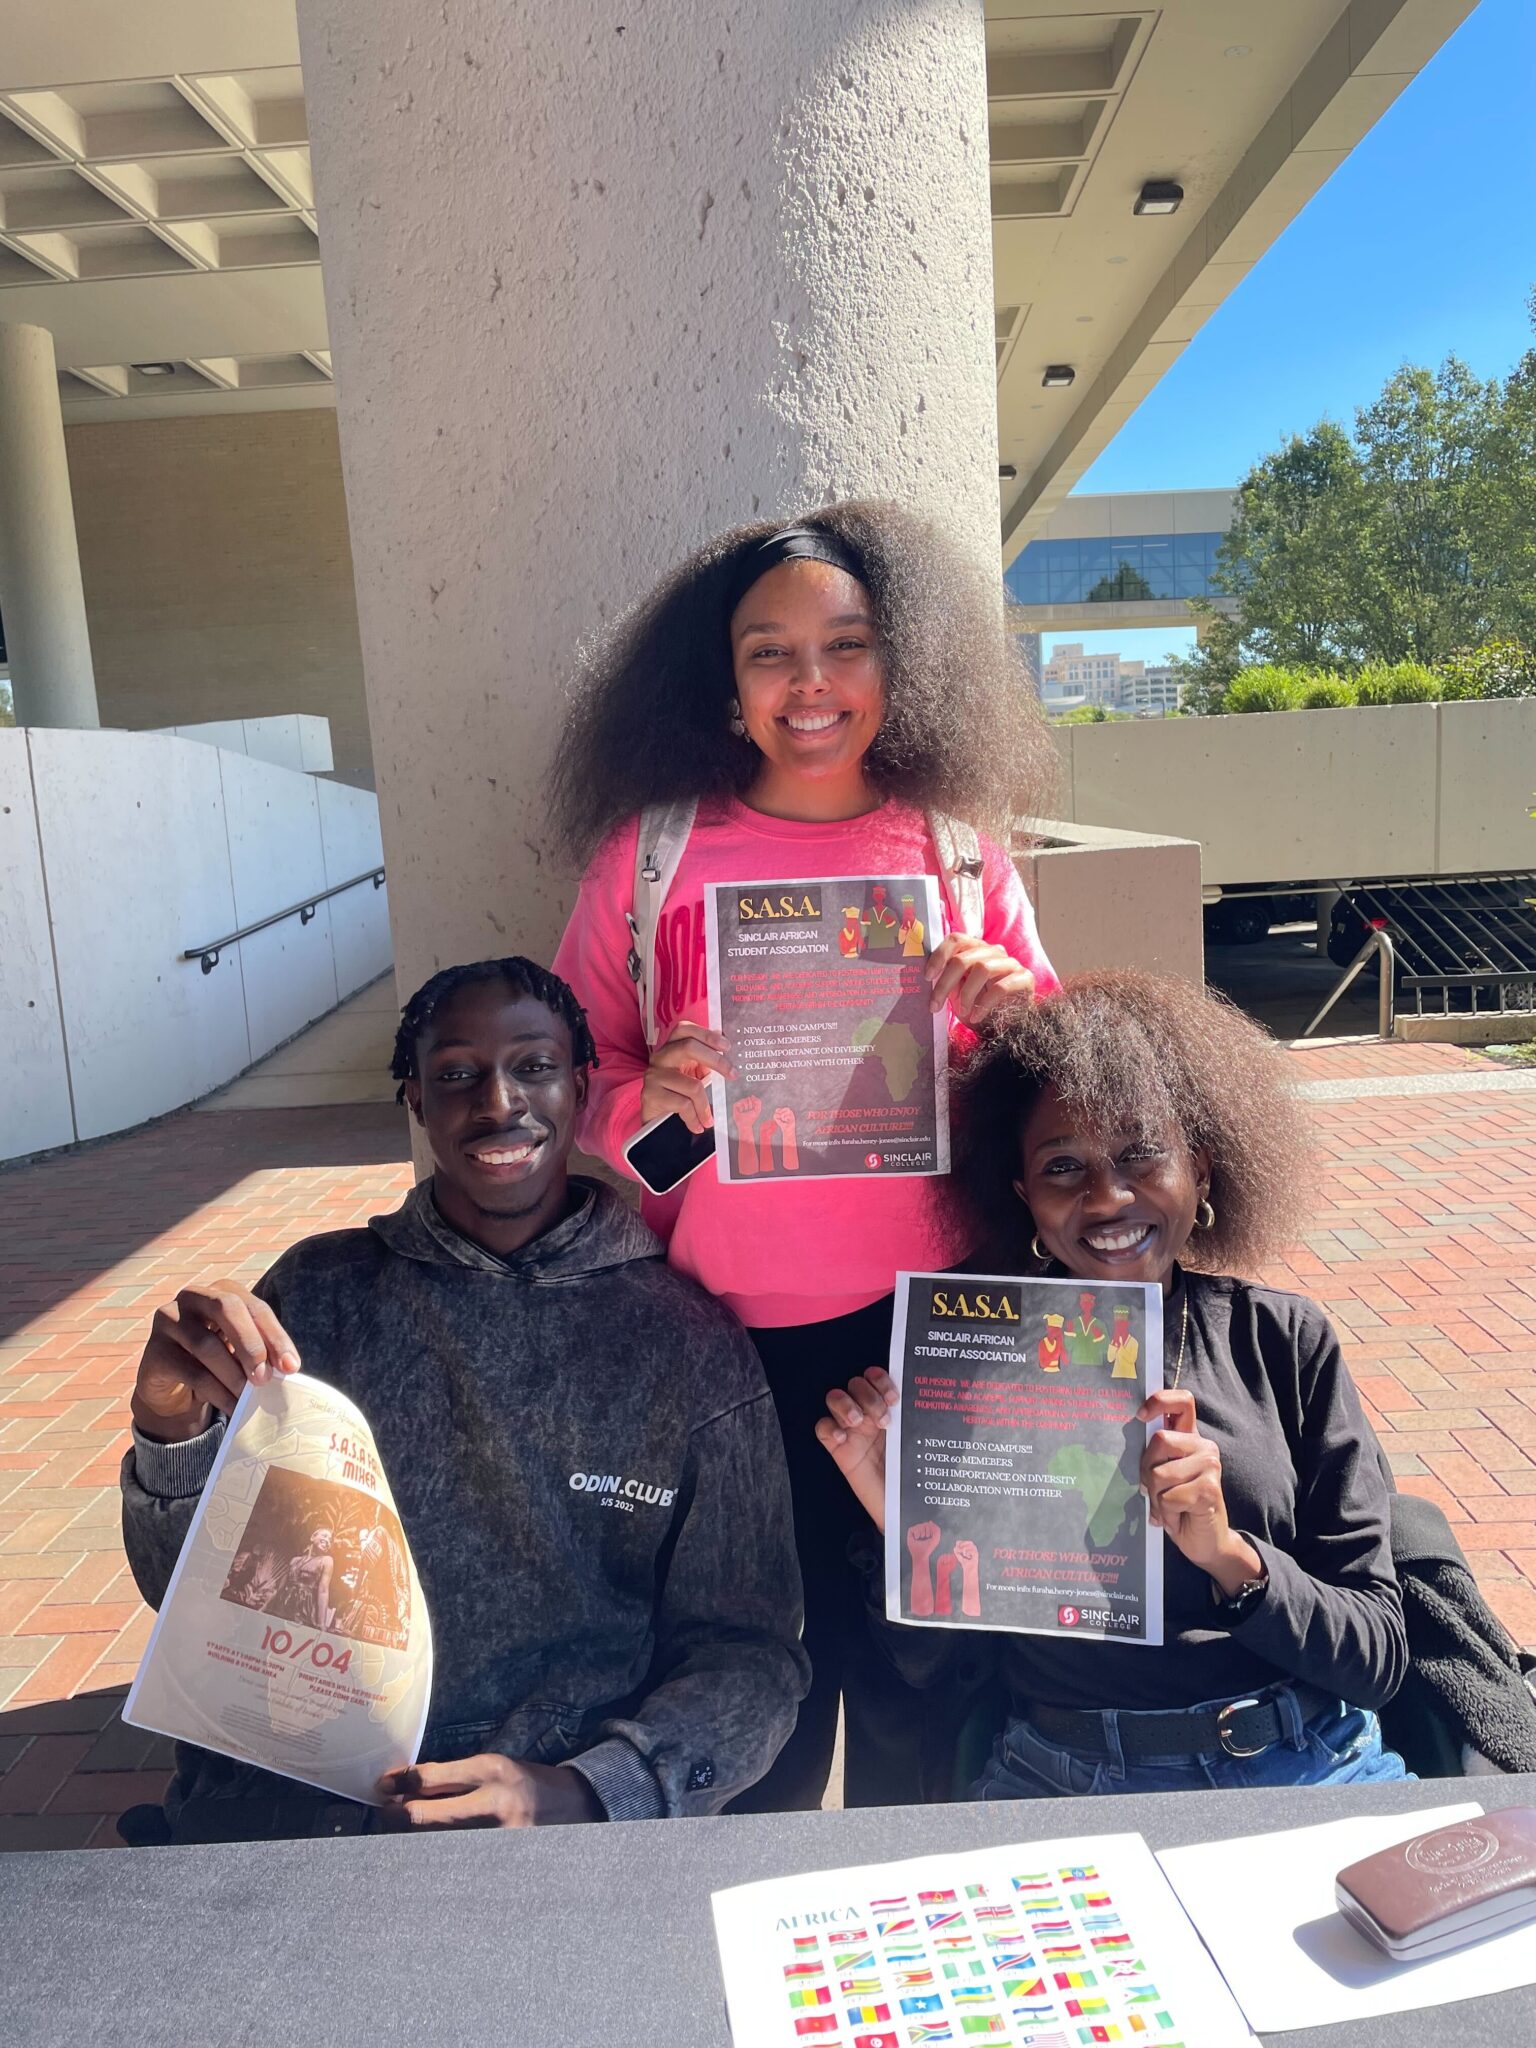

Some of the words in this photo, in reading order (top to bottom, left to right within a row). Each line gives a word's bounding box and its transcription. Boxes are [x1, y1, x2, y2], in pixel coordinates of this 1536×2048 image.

[739, 895, 821, 920] S.A.S.A.
[738, 932, 778, 942] SINCLAIR
[780, 930, 818, 941] AFRICAN
[728, 946, 769, 957] STUDENT
[769, 944, 829, 955] ASSOCIATION
[743, 1026, 762, 1034] NEW
[764, 1025, 785, 1034] CLUB
[786, 1024, 798, 1032] ON
[744, 1038, 766, 1046] OVER
[745, 1050, 767, 1058] HIGH
[767, 1048, 820, 1057] IMPORTANCE
[821, 1046, 833, 1054] ON
[834, 1044, 876, 1054] DIVERSITY
[746, 1060, 812, 1070] COLLABORATION
[814, 1058, 836, 1066] WITH
[836, 1057, 864, 1066] OTHER
[746, 1073, 786, 1082] COLLEGES
[808, 1110, 829, 1120] FOR
[830, 1108, 862, 1119] THOSE
[863, 1107, 889, 1118] WHO
[889, 1106, 920, 1117] ENJOY
[815, 1124, 859, 1134] AFRICAN
[884, 1152, 932, 1162] SINCLAIR
[932, 1292, 1020, 1320] S.A.S.A.
[928, 1330, 971, 1343] SINCLAIR
[972, 1334, 1015, 1346] AFRICAN
[914, 1346, 958, 1358] STUDENT
[959, 1349, 1027, 1363] ASSOCIATION
[329, 1432, 366, 1465] S.A.S.A
[925, 1438, 946, 1448] NEW
[948, 1440, 972, 1450] CLUB
[972, 1442, 987, 1451] ON
[925, 1453, 950, 1462] OVER
[950, 1456, 960, 1464] 60
[962, 1456, 1014, 1467] MEMEBERS
[925, 1467, 949, 1477] HIGH
[950, 1469, 1011, 1482] IMPORTANCE
[1012, 1472, 1027, 1482] ON
[1028, 1474, 1077, 1485] DIVERSITY
[924, 1482, 1001, 1495] COLLABORATION
[1002, 1486, 1028, 1496] WITH
[1029, 1488, 1062, 1498] OTHER
[600, 1498, 614, 1507] S/S
[614, 1500, 634, 1512] 2022
[924, 1496, 970, 1508] COLLEGES
[993, 1548, 1017, 1560] FOR
[1018, 1550, 1058, 1561] THOSE
[1059, 1551, 1090, 1562] WHO
[1090, 1554, 1128, 1567] ENJOY
[1002, 1567, 1054, 1580] AFRICAN
[1080, 1608, 1140, 1625] SINCLAIR
[1090, 1619, 1131, 1630] COLLEGE
[261, 1625, 353, 1674] 10/04
